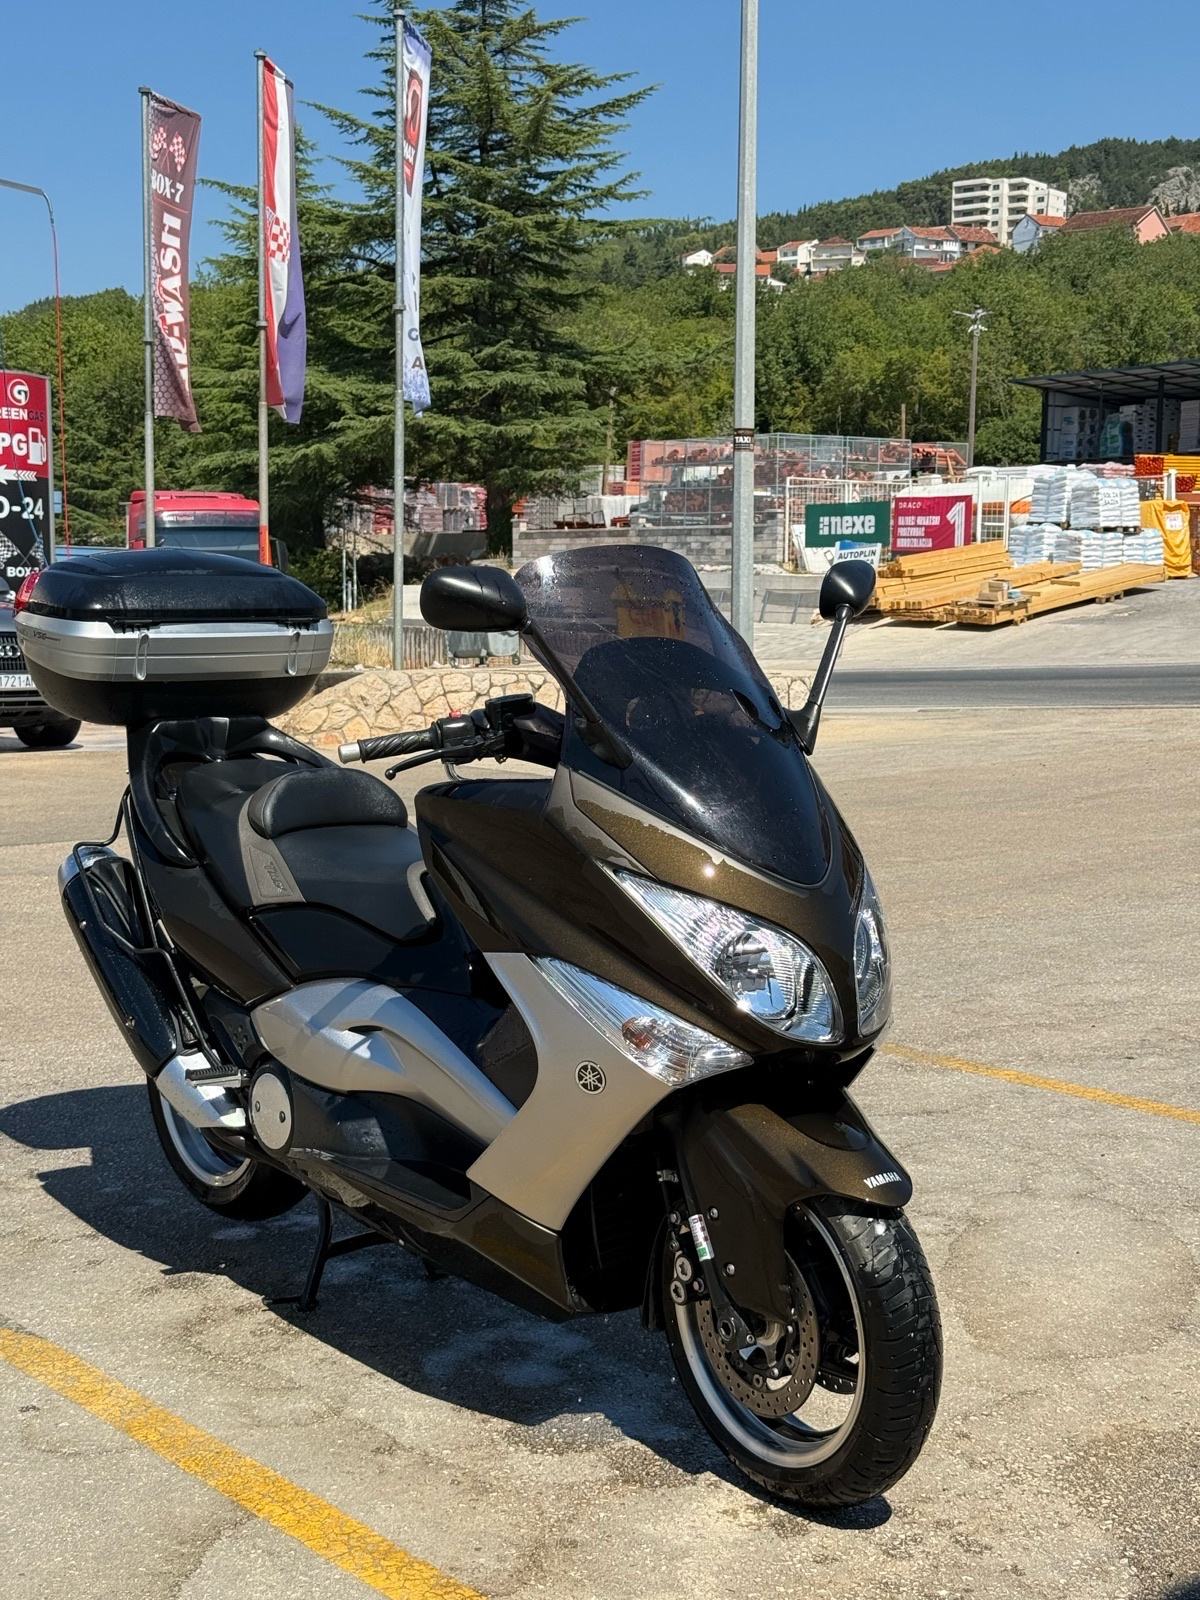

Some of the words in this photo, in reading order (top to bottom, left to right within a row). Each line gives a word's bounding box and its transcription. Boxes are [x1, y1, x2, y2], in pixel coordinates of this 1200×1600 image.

[151, 168, 185, 204] BOX-7
[734, 435, 752, 444] TAXI
[898, 501, 922, 509] DRACO
[830, 514, 876, 535] nexe
[837, 548, 877, 560] AUTOPLIN
[863, 1171, 902, 1189] YAMAHA
